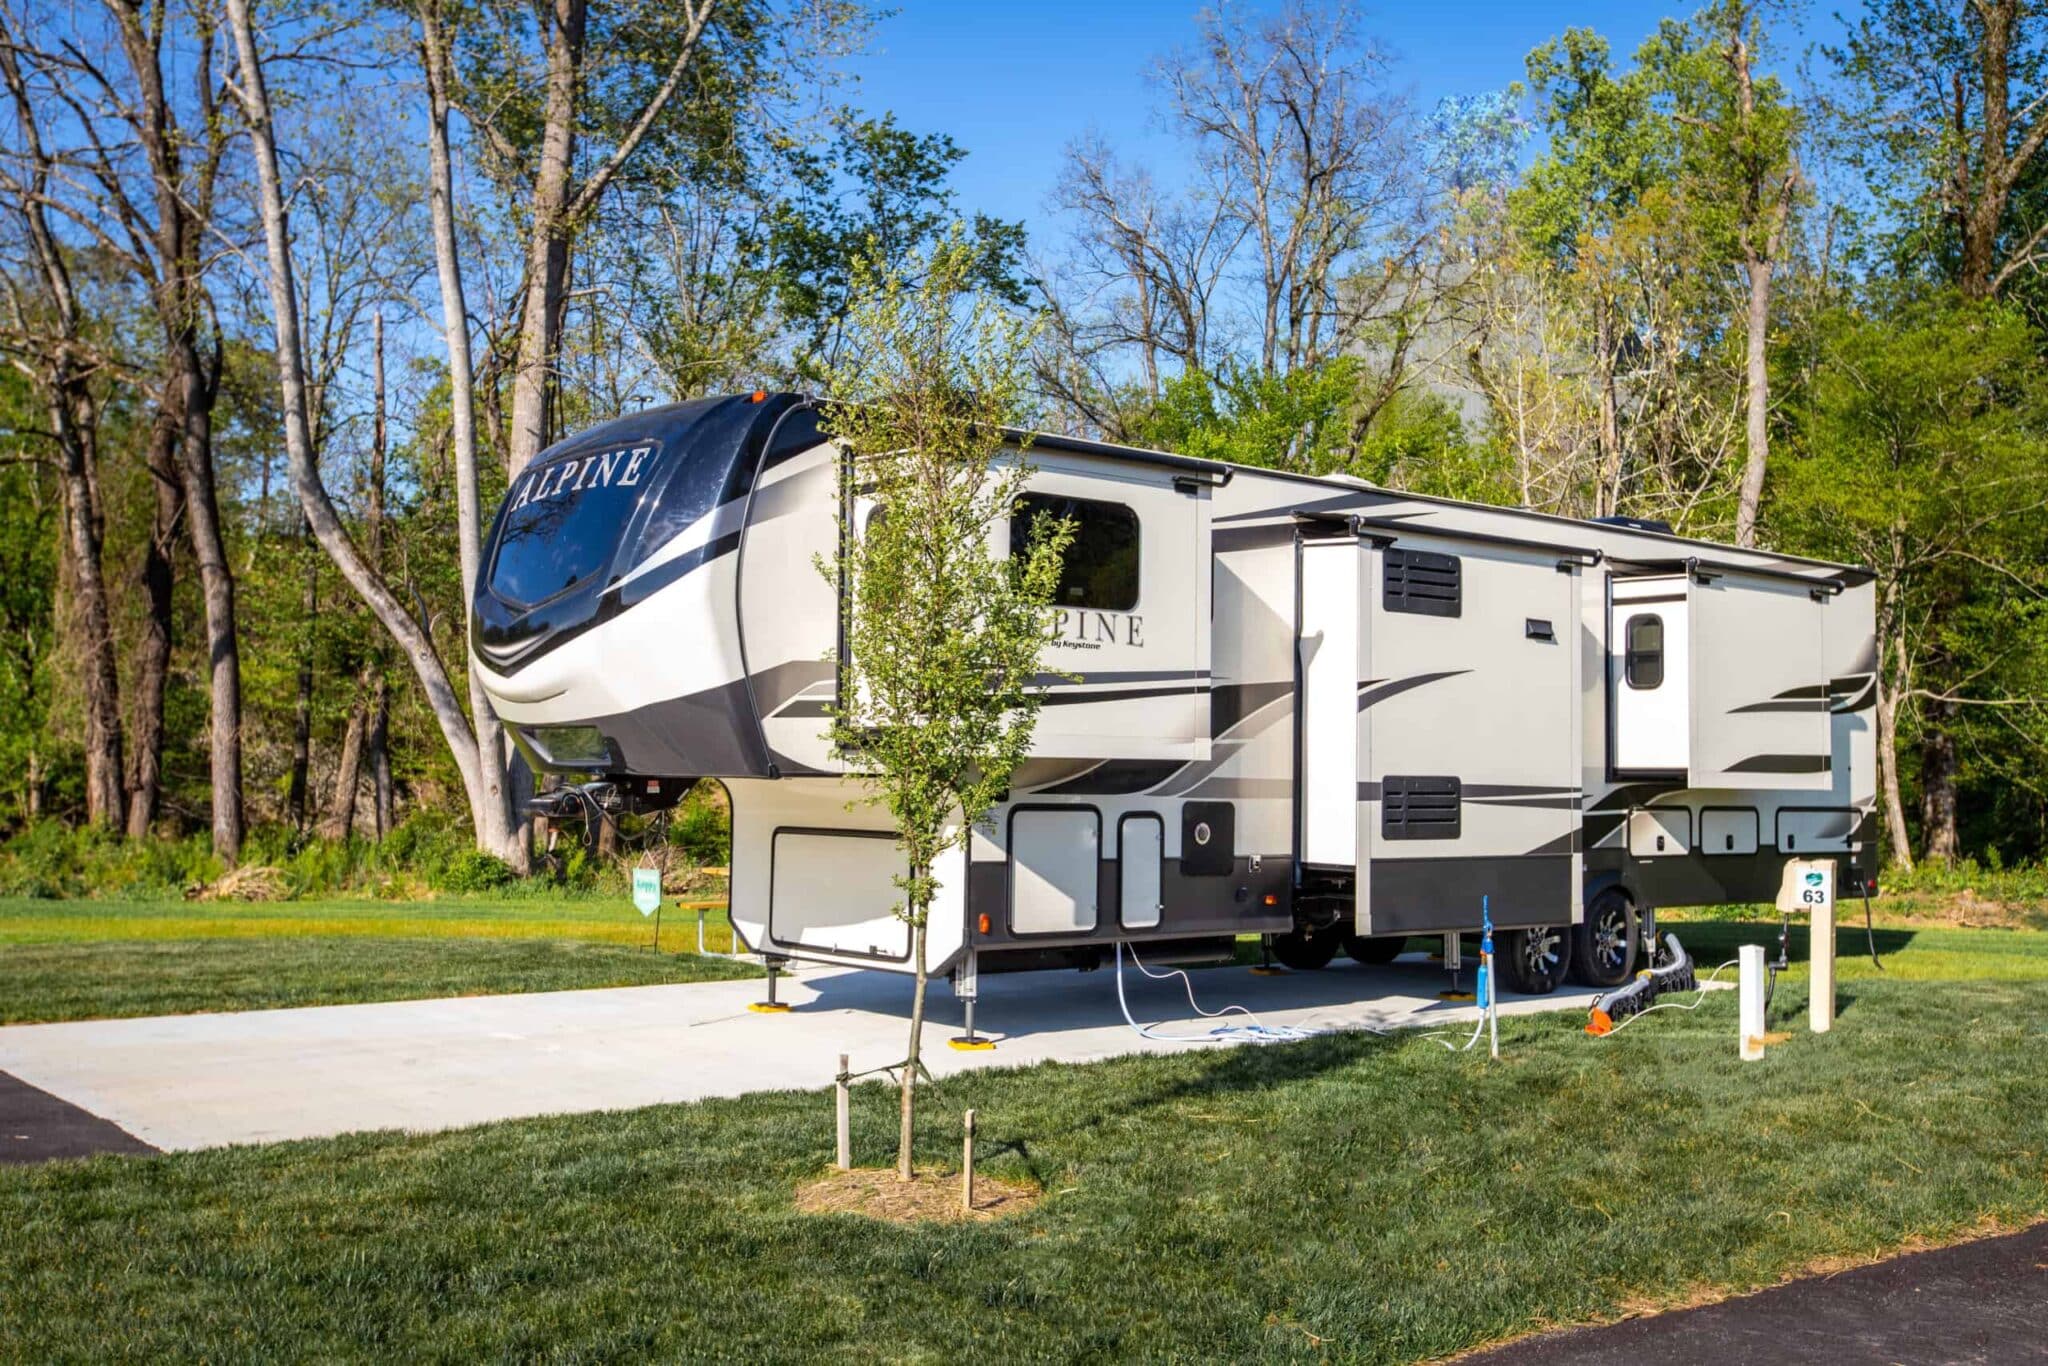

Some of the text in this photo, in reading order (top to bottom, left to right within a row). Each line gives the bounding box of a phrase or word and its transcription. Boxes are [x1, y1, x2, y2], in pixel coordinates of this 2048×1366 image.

[510, 447, 651, 513] ALPINE
[1050, 608, 1144, 648] PINE
[1051, 639, 1101, 650] by Keystone
[1803, 889, 1825, 904] 63
